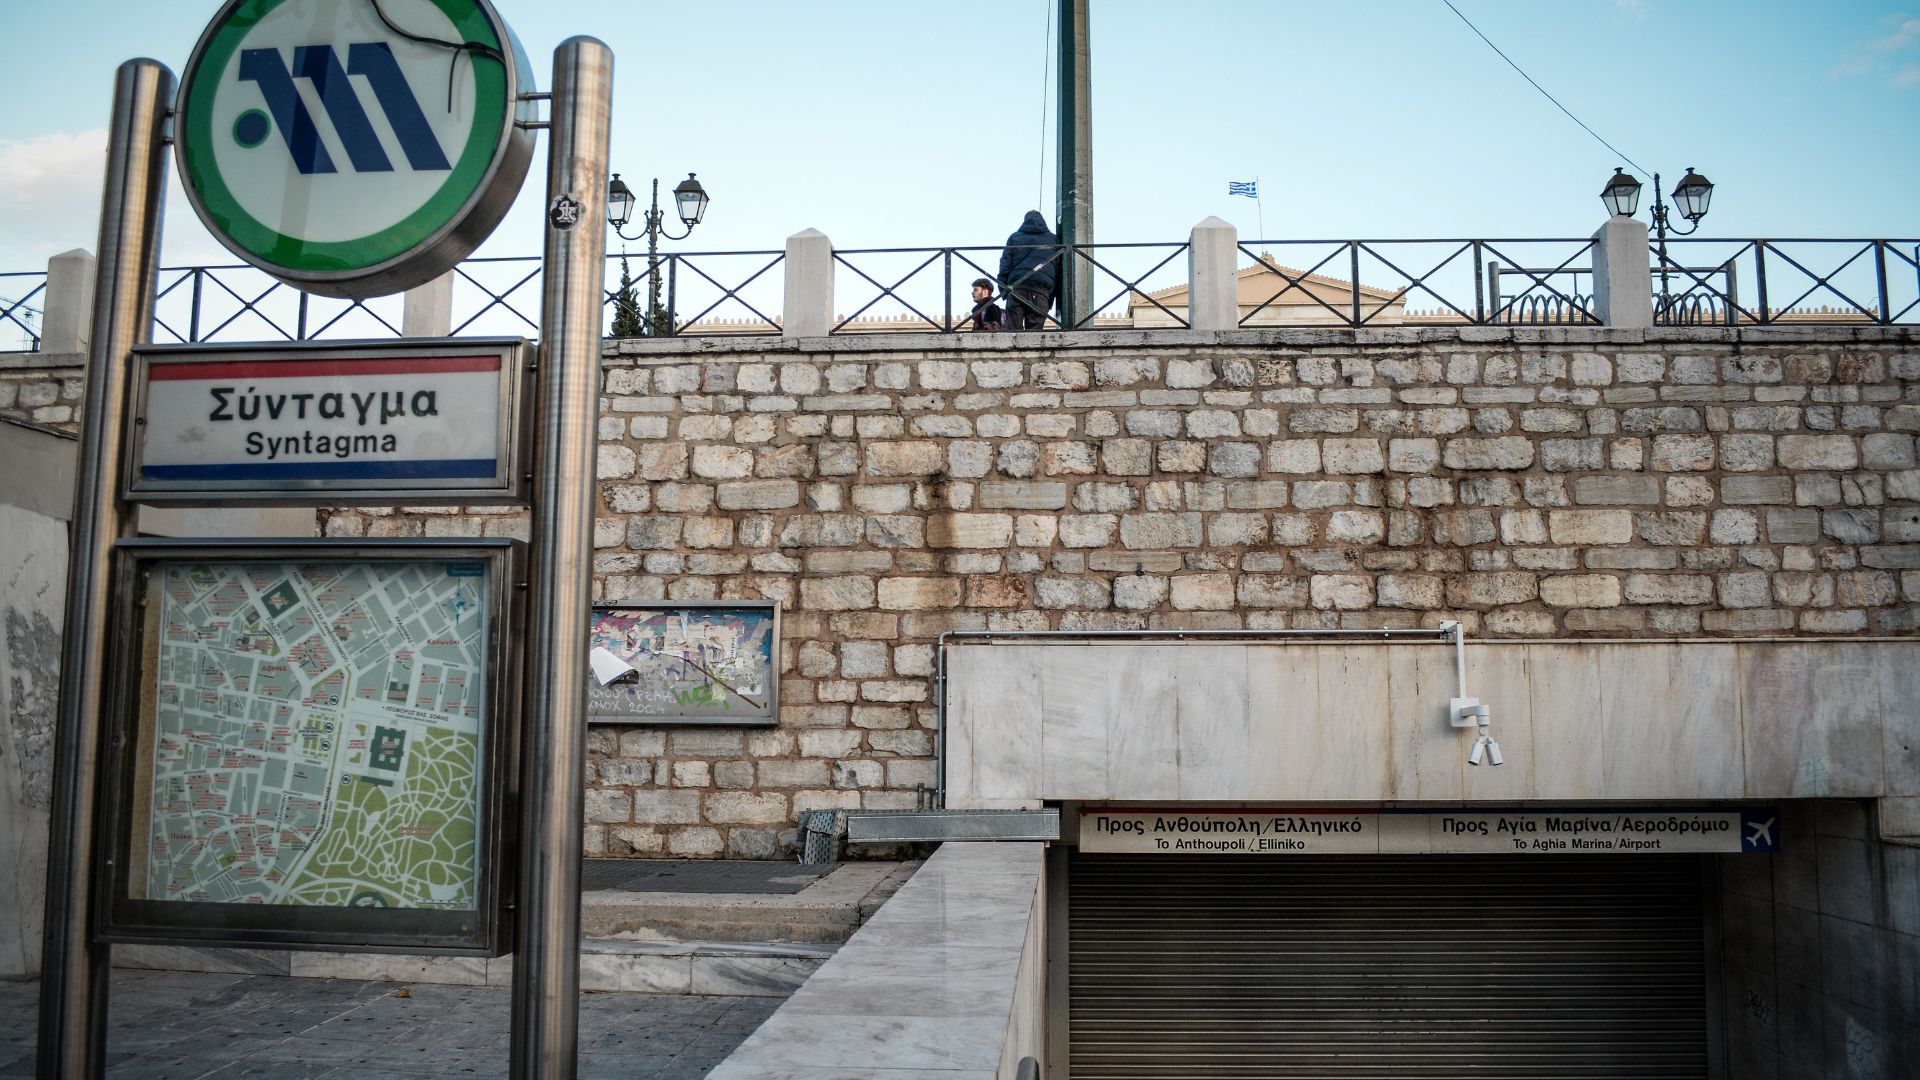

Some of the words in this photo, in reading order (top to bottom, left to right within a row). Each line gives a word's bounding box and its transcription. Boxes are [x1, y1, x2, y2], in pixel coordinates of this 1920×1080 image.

[208, 386, 438, 426] Σύνταγμα
[245, 431, 397, 460] Syntagma
[1096, 816, 1145, 835] Προς
[1442, 817, 1488, 835] Προς
[1496, 817, 1537, 835] Αγία
[1154, 838, 1170, 850] To
[1513, 838, 1527, 850] To
[1532, 838, 1567, 851] Aghia
